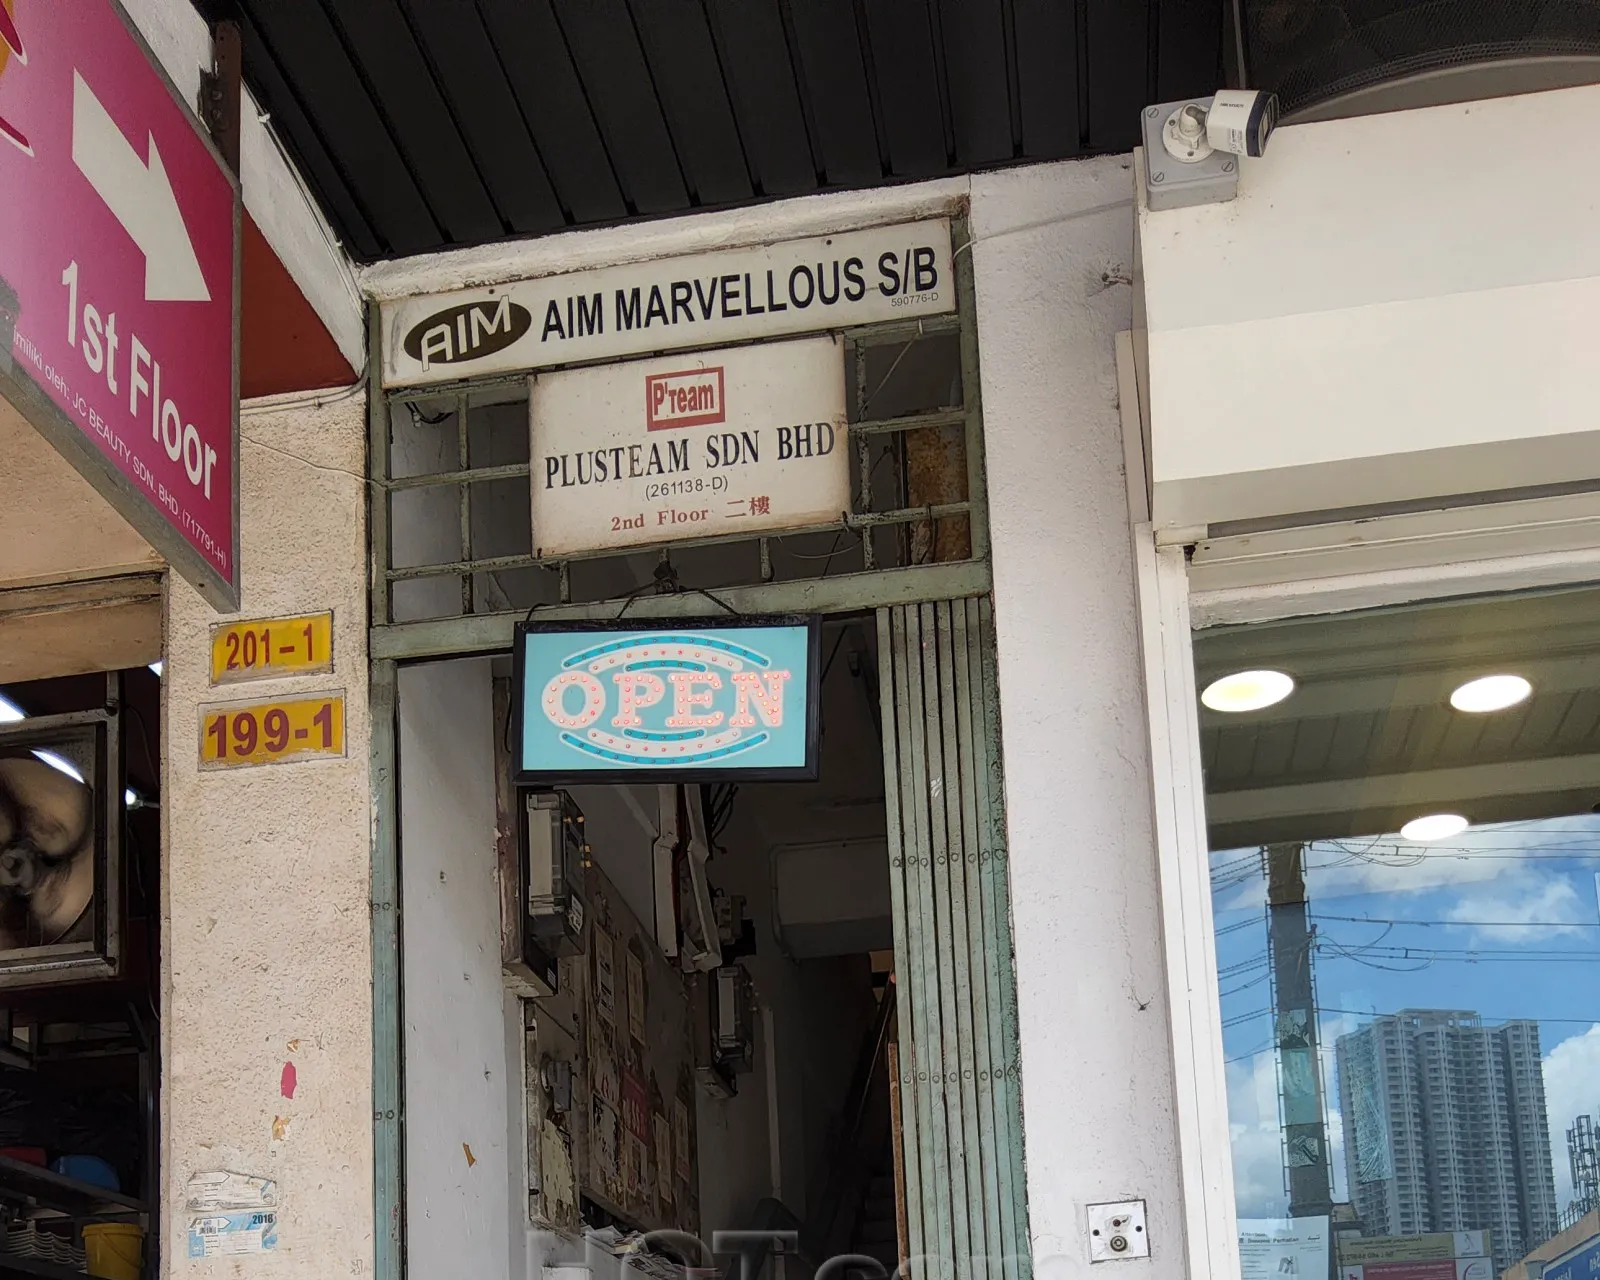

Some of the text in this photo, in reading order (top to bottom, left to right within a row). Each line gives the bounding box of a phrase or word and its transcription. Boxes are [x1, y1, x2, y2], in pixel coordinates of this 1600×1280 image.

[541, 246, 938, 342] AIM MARVELLOUS S/B
[890, 291, 939, 308] 590776-D
[420, 294, 512, 373] AIM
[62, 259, 217, 500] 1st Floor
[44, 365, 70, 400] oleh:
[72, 392, 87, 417] JC
[89, 407, 131, 464] BEAUTY
[132, 456, 157, 494] SDN.
[158, 482, 181, 520] BHD.
[182, 509, 227, 569] (717791-H)
[545, 421, 835, 490] PLUSTEAM SDN BHD
[645, 474, 729, 501] (261138-D)
[611, 508, 709, 532] 2nd Floor
[208, 703, 332, 759] 199-1
[541, 670, 790, 729] OPEN
